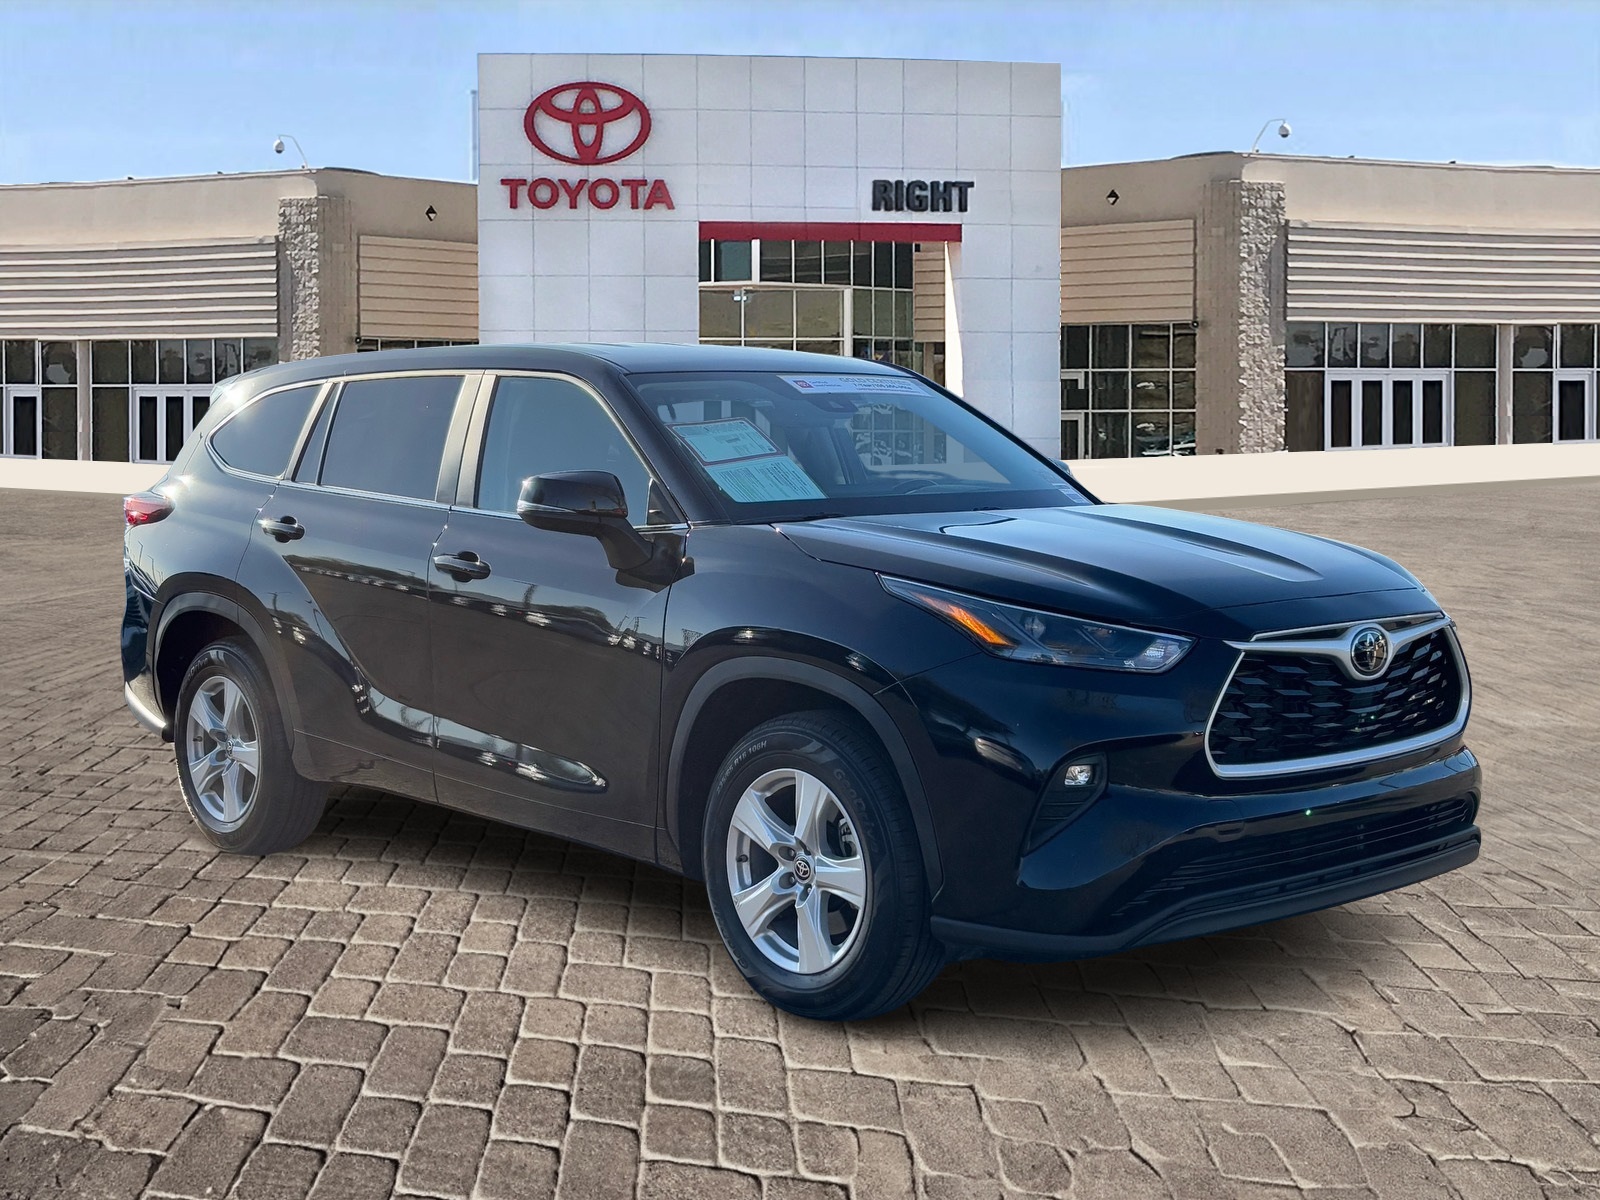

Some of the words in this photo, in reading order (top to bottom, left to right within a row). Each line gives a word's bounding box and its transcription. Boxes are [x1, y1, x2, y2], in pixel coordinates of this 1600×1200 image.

[500, 179, 676, 210] TOYOTA
[871, 179, 976, 213] RIGHT
[748, 740, 767, 754] 106H
